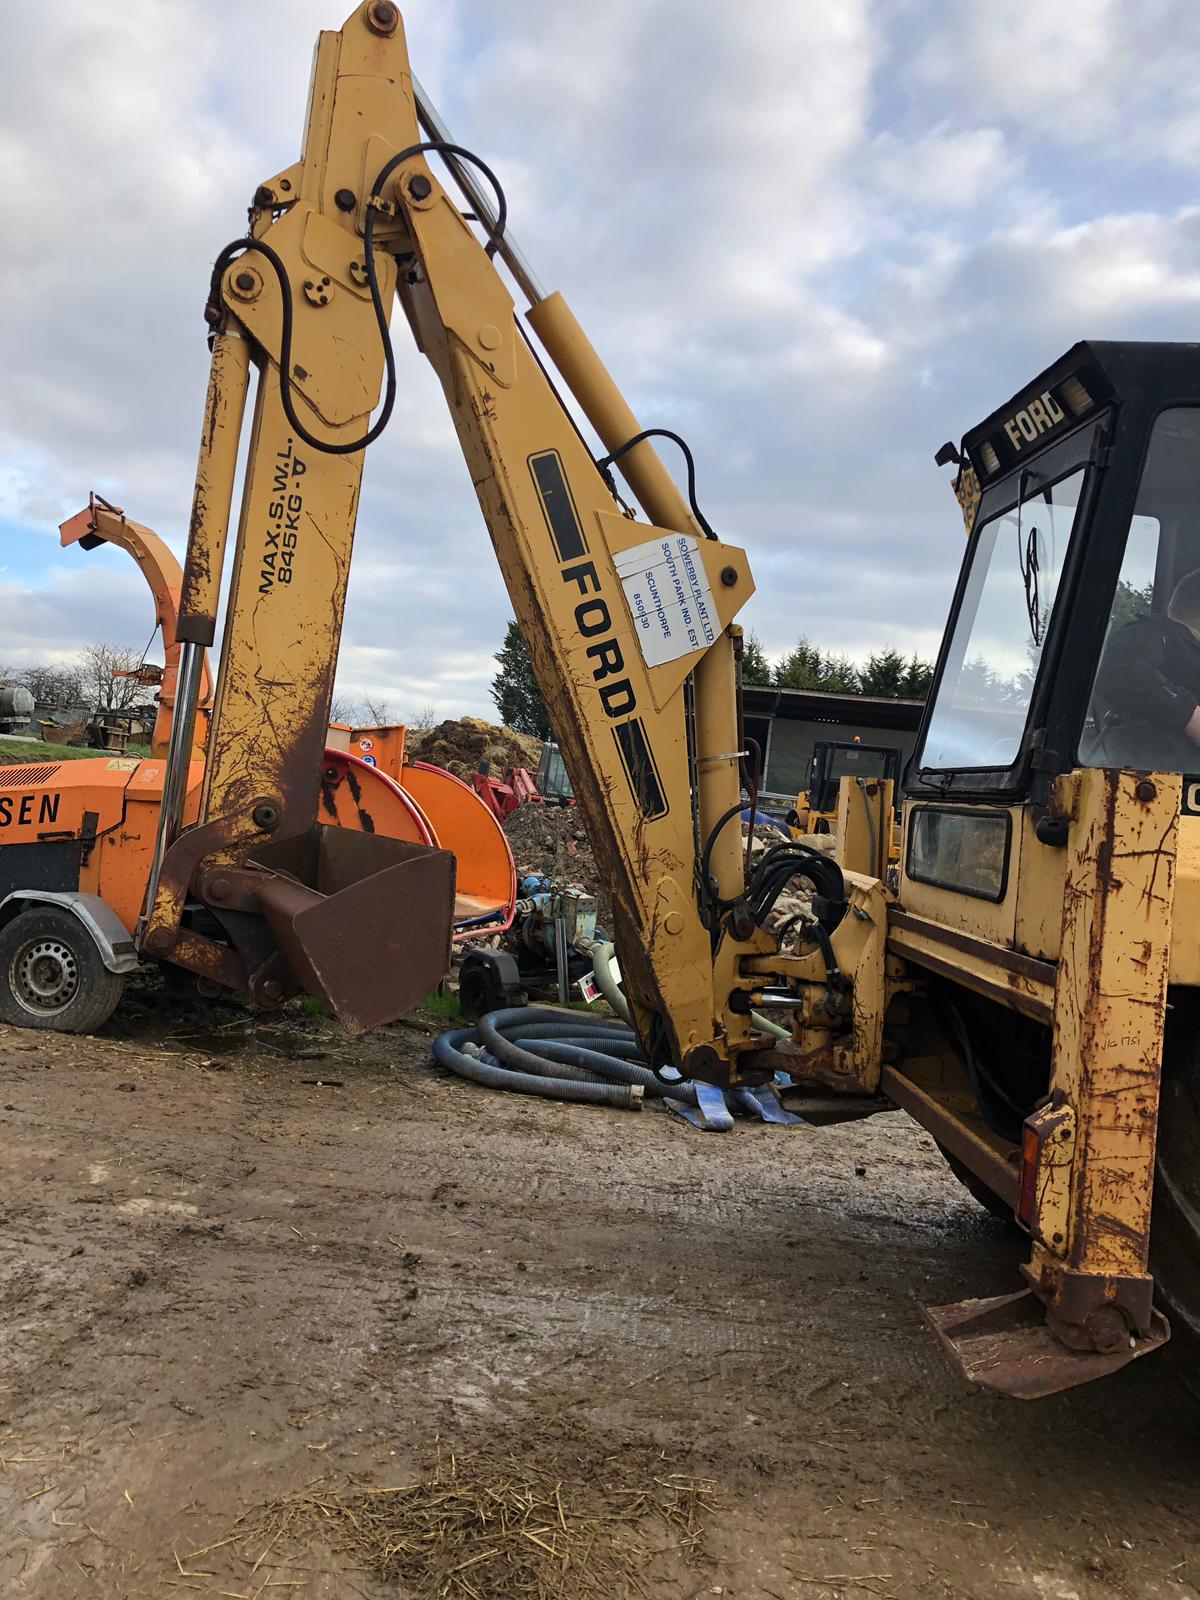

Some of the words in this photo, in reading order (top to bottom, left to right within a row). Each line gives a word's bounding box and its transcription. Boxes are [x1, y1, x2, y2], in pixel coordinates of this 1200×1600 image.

[1003, 390, 1065, 451] FORD
[645, 571, 672, 639] SCUNTHORPE
[662, 542, 678, 577] SOUTH
[672, 579, 686, 606] PARK
[681, 607, 692, 628] IND.
[678, 537, 700, 588] SOWERBY
[693, 589, 709, 622] PLANT
[560, 560, 637, 719] FORD
